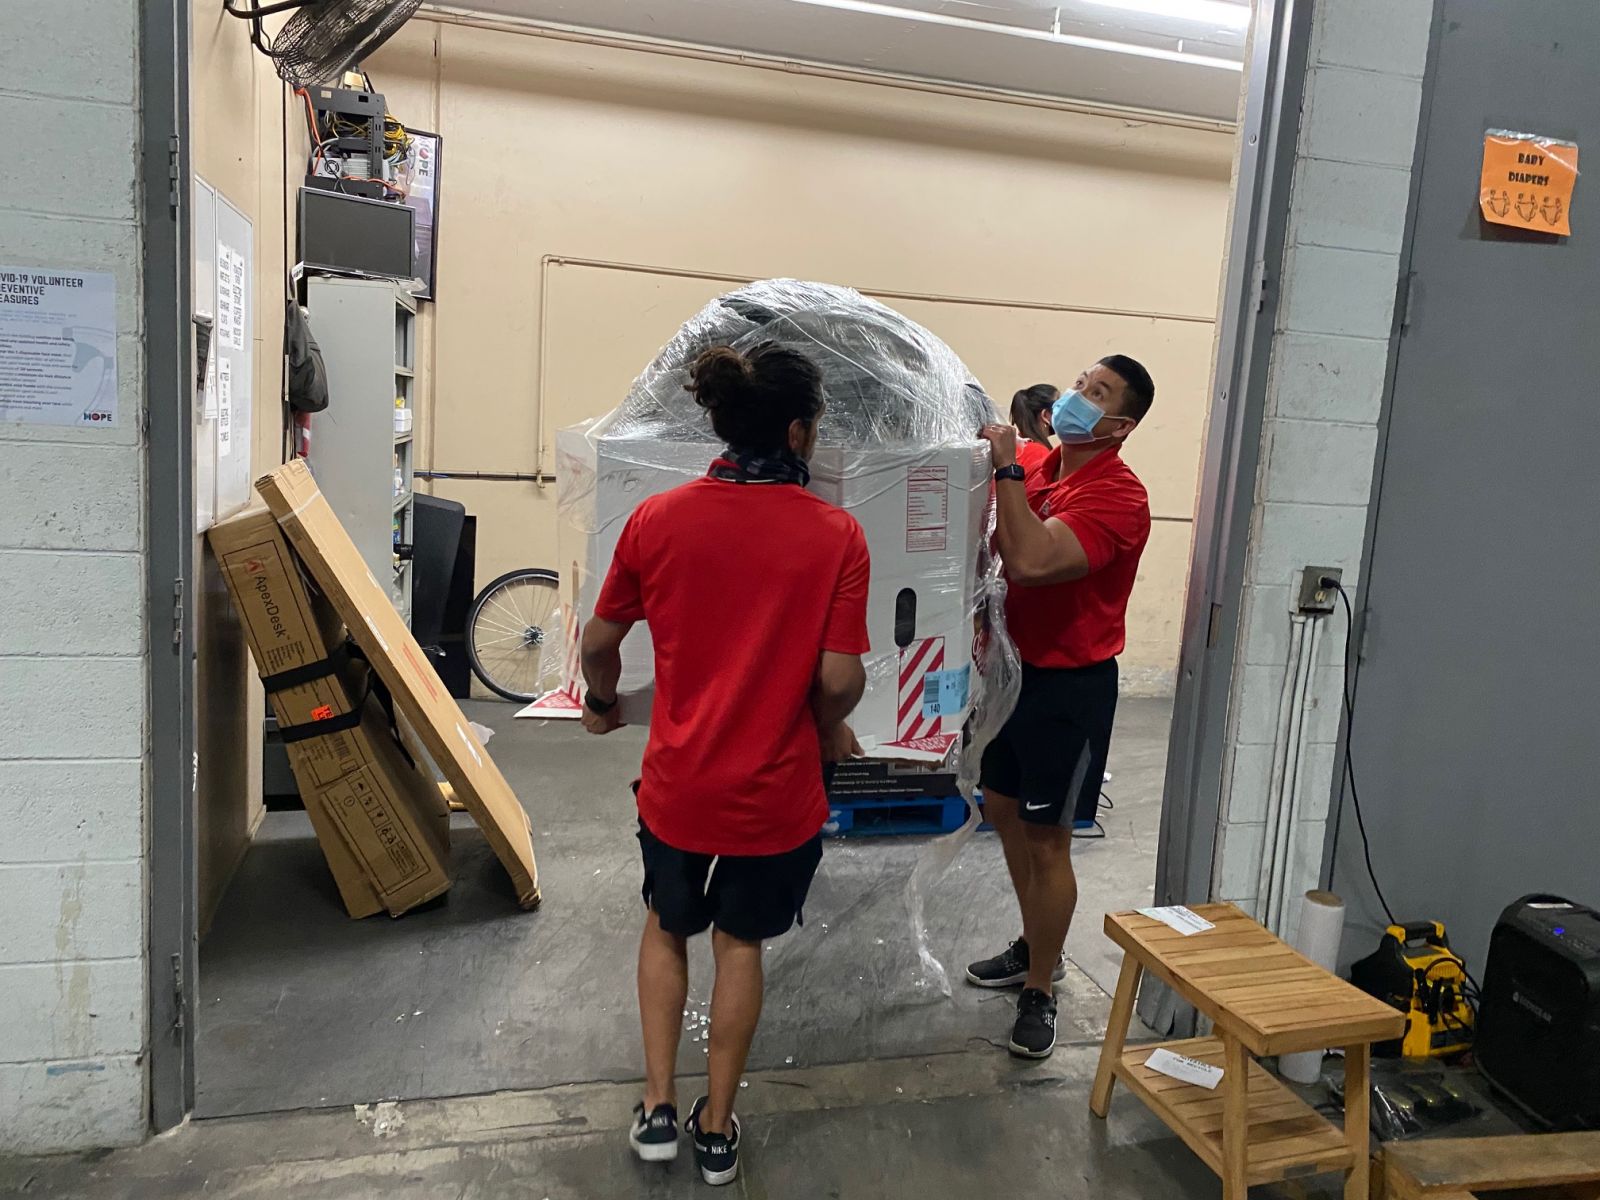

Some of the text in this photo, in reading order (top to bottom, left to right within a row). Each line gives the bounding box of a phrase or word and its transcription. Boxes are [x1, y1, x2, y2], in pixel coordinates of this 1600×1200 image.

[1518, 153, 1545, 166] BABY
[1508, 171, 1550, 186] DIAPERS
[31, 275, 83, 288] VOLUNTEER
[83, 412, 112, 421] HOPE
[255, 575, 288, 639] ApexDesk
[930, 703, 941, 714] 140
[711, 1144, 727, 1155] NIKE
